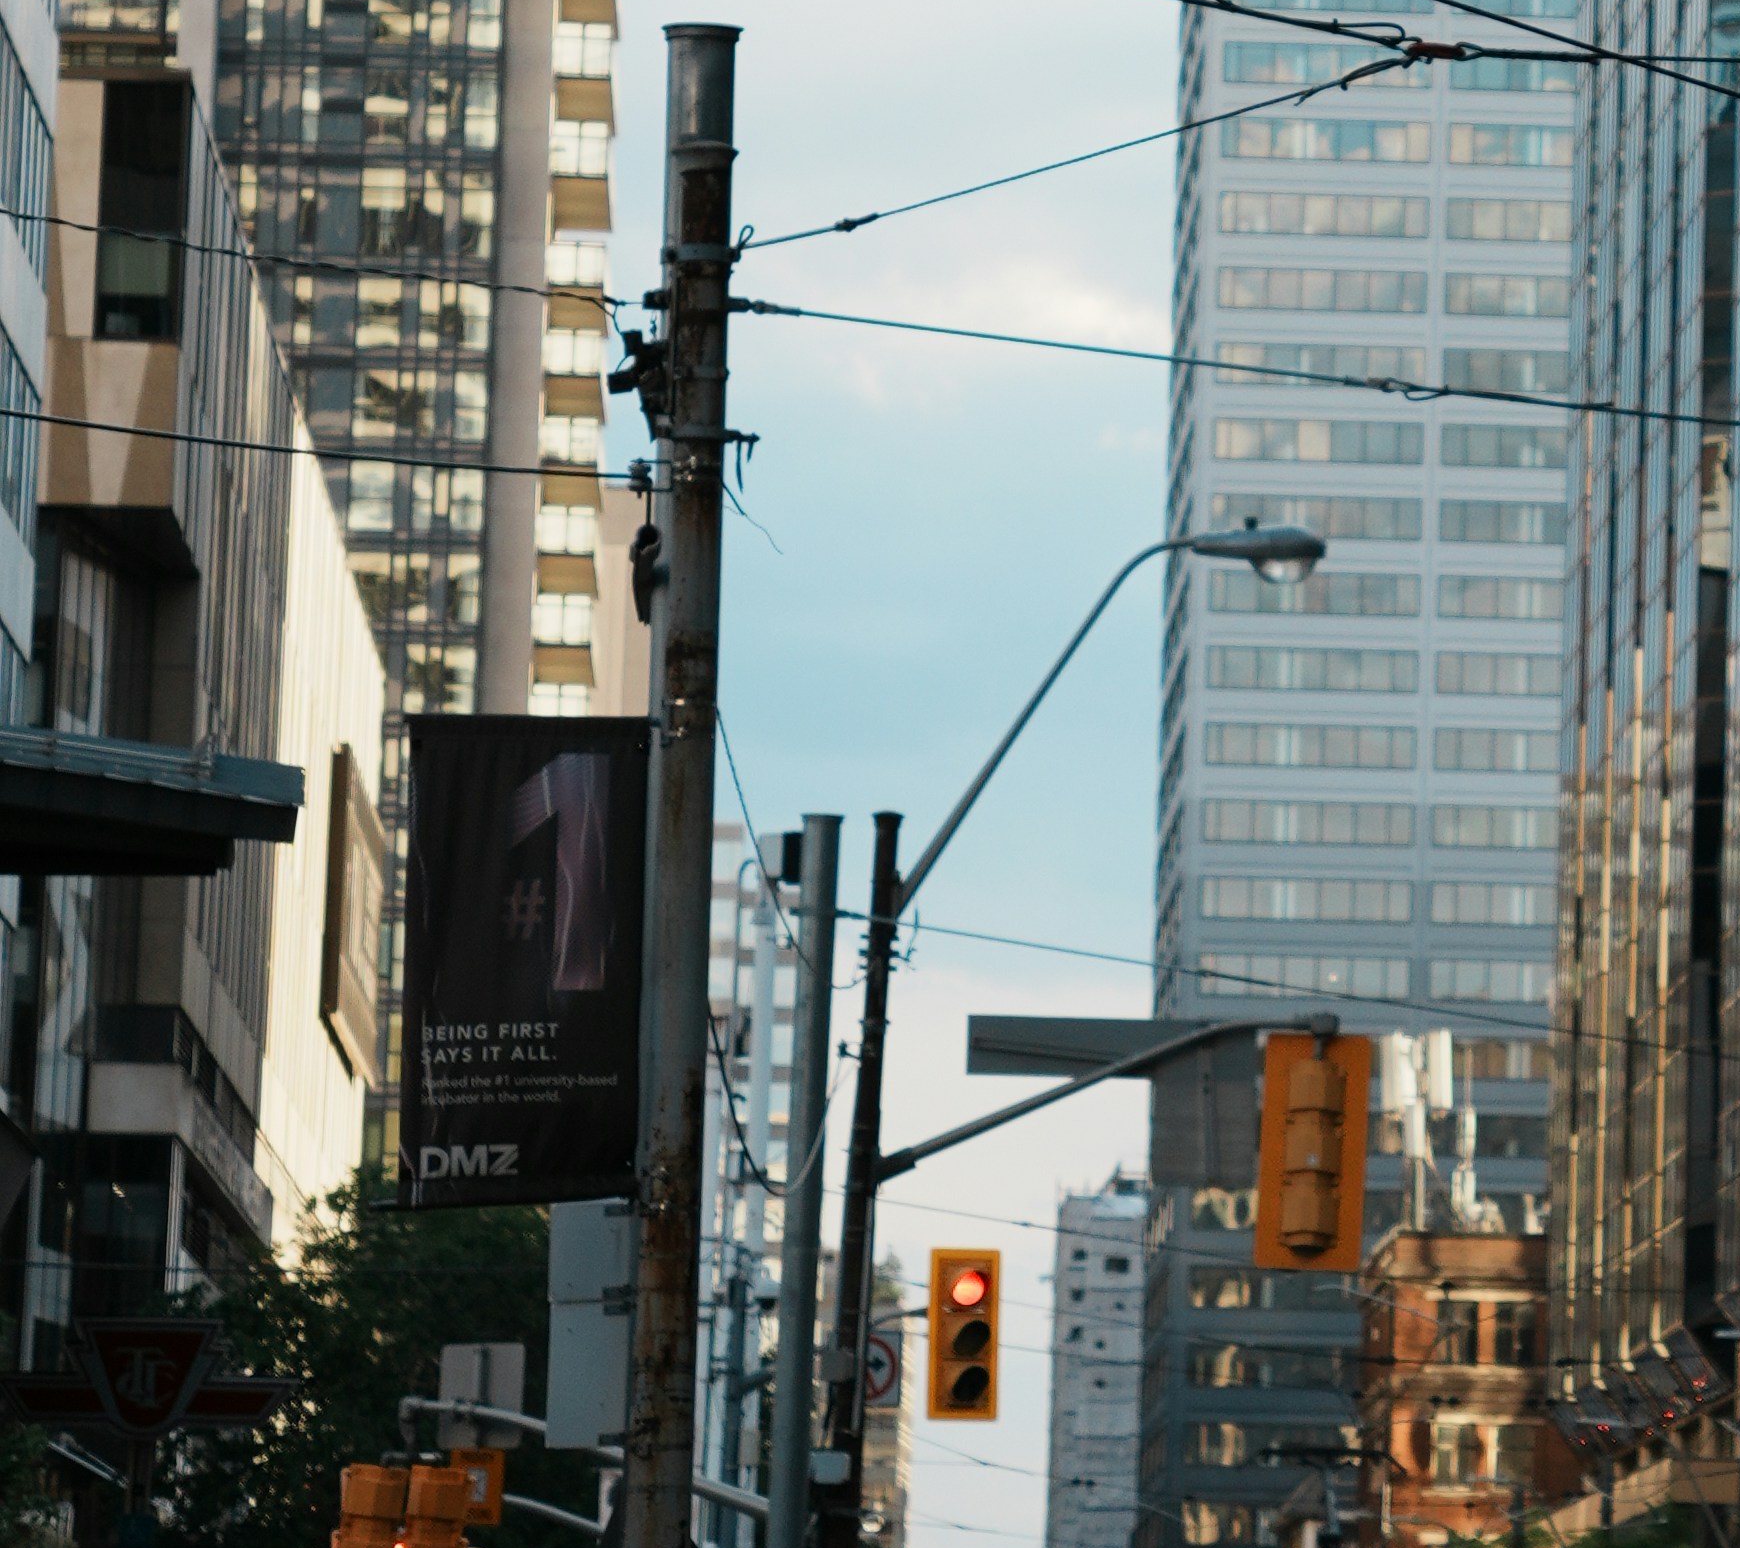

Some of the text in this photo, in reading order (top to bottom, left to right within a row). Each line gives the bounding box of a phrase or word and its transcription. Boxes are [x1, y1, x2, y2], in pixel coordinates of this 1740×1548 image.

[422, 1023, 559, 1042] BEING FIRST
[421, 1046, 557, 1064] SAYS IT ALL.
[471, 1074, 491, 1087] the
[514, 1074, 618, 1090] university-based
[483, 1091, 494, 1103] in
[499, 1091, 519, 1103] the
[419, 1144, 519, 1179] DMZ
